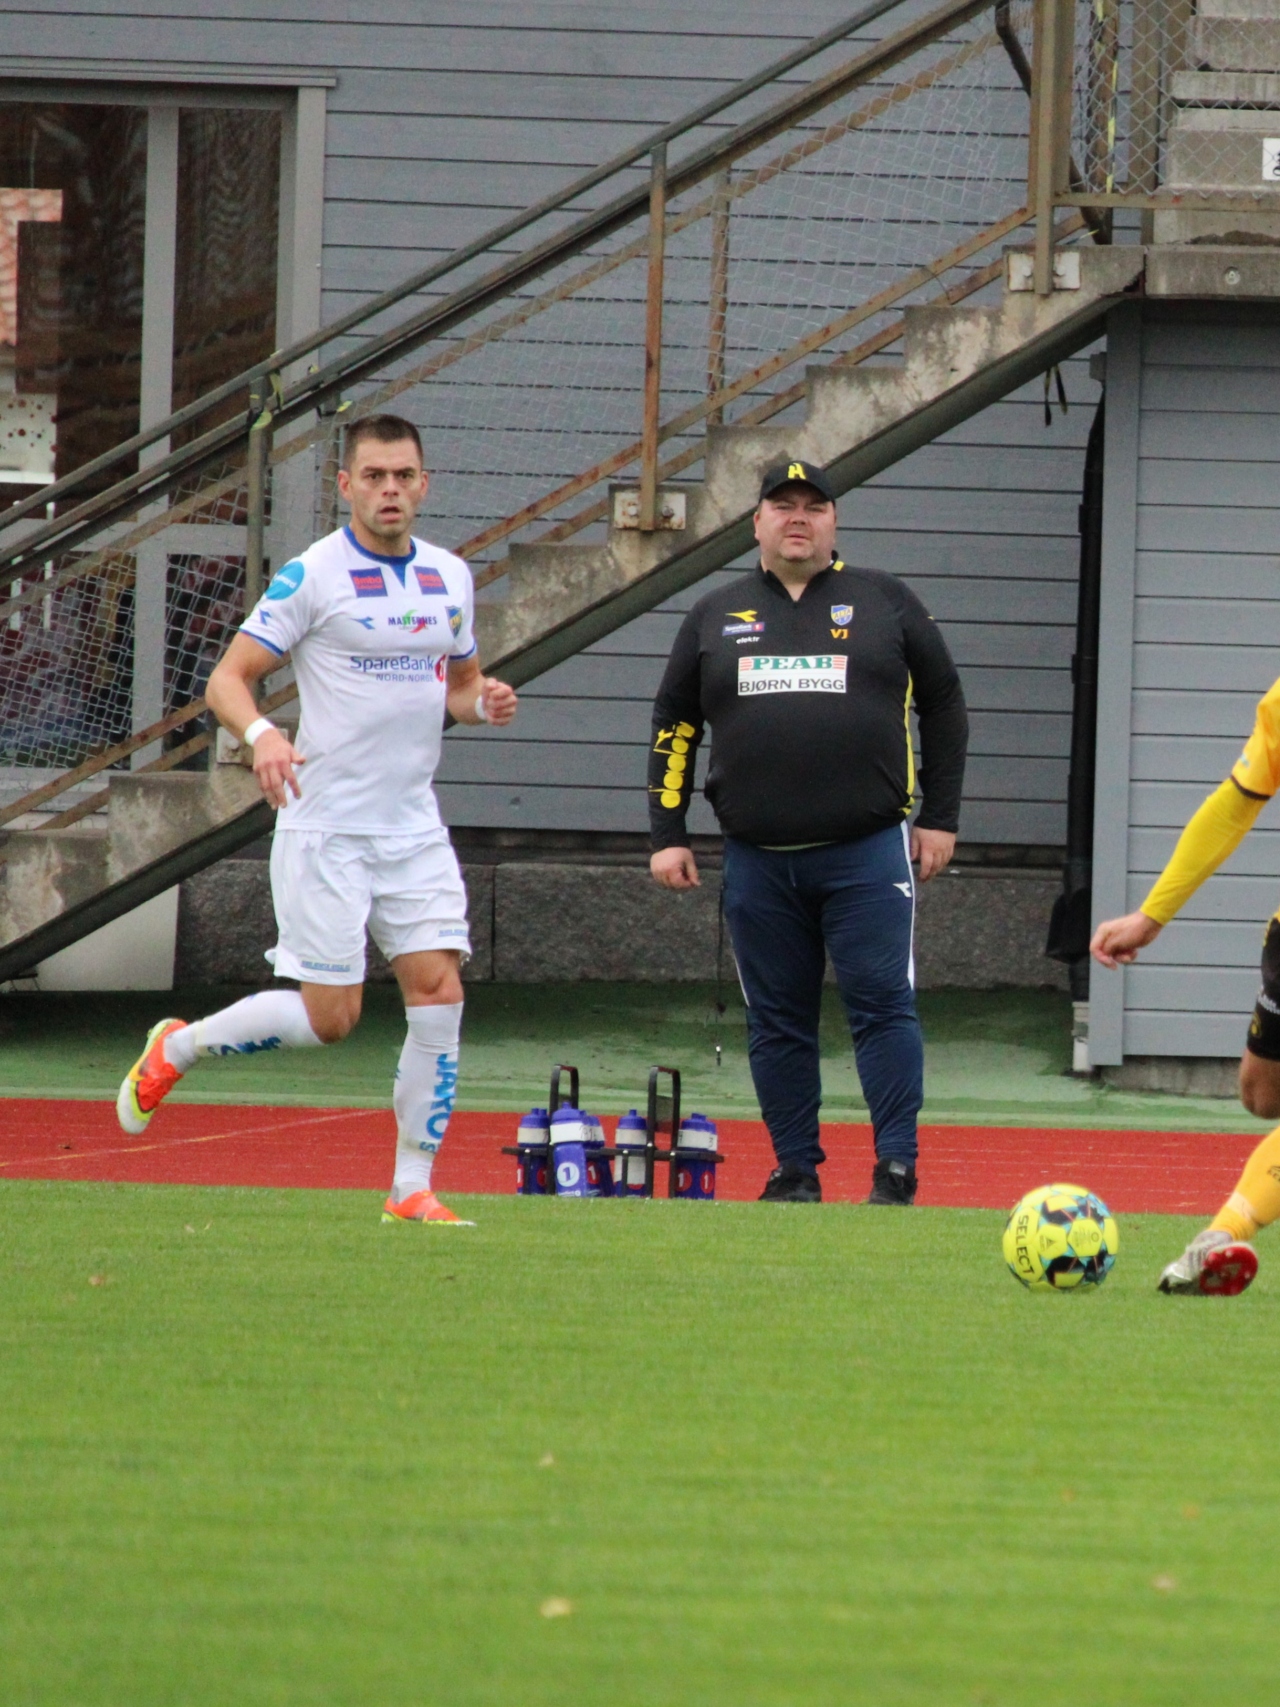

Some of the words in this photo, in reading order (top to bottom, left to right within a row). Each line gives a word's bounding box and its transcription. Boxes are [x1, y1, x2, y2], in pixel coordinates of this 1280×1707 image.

[830, 628, 849, 639] VJ
[350, 655, 434, 672] SpareBank
[751, 656, 832, 670] PEAB
[376, 673, 434, 683] NORD-NORGE
[739, 680, 792, 693] BJØRN
[798, 679, 844, 690] BYGG
[562, 1166, 571, 1182] 1
[588, 1165, 596, 1180] 1
[678, 1172, 685, 1188] 1
[704, 1174, 709, 1190] 1
[1015, 1214, 1036, 1275] SELECT
